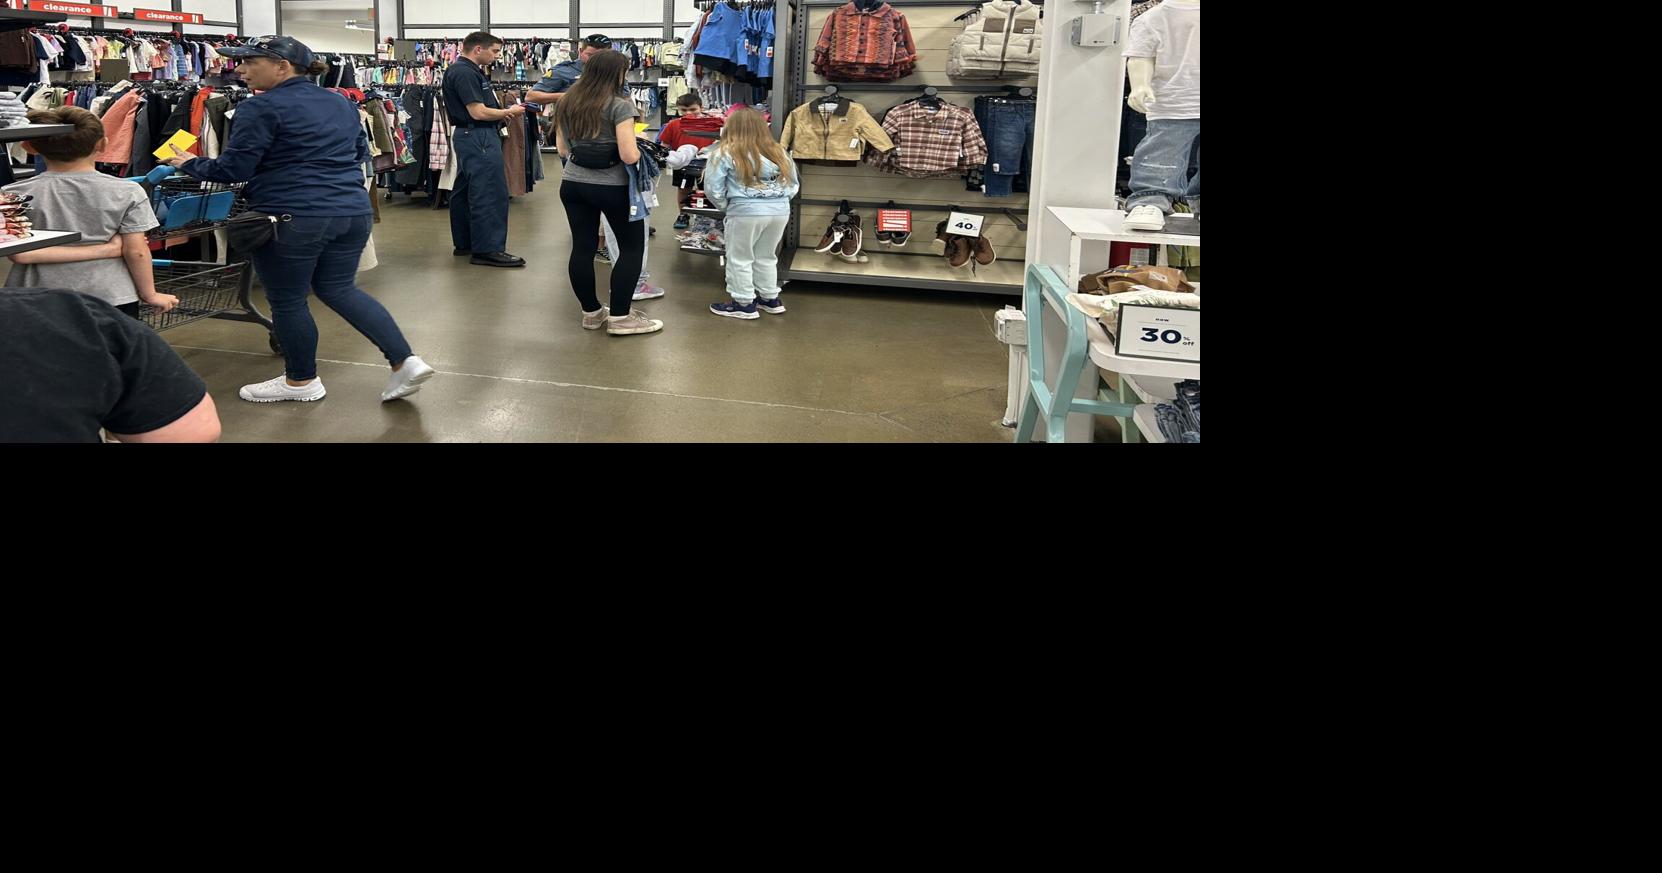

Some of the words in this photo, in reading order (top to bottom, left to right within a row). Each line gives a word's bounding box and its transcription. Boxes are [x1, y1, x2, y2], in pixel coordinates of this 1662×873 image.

[43, 3, 92, 14] clearance
[146, 12, 184, 21] clearance
[955, 222, 973, 230] 40
[1140, 327, 1182, 344] 30
